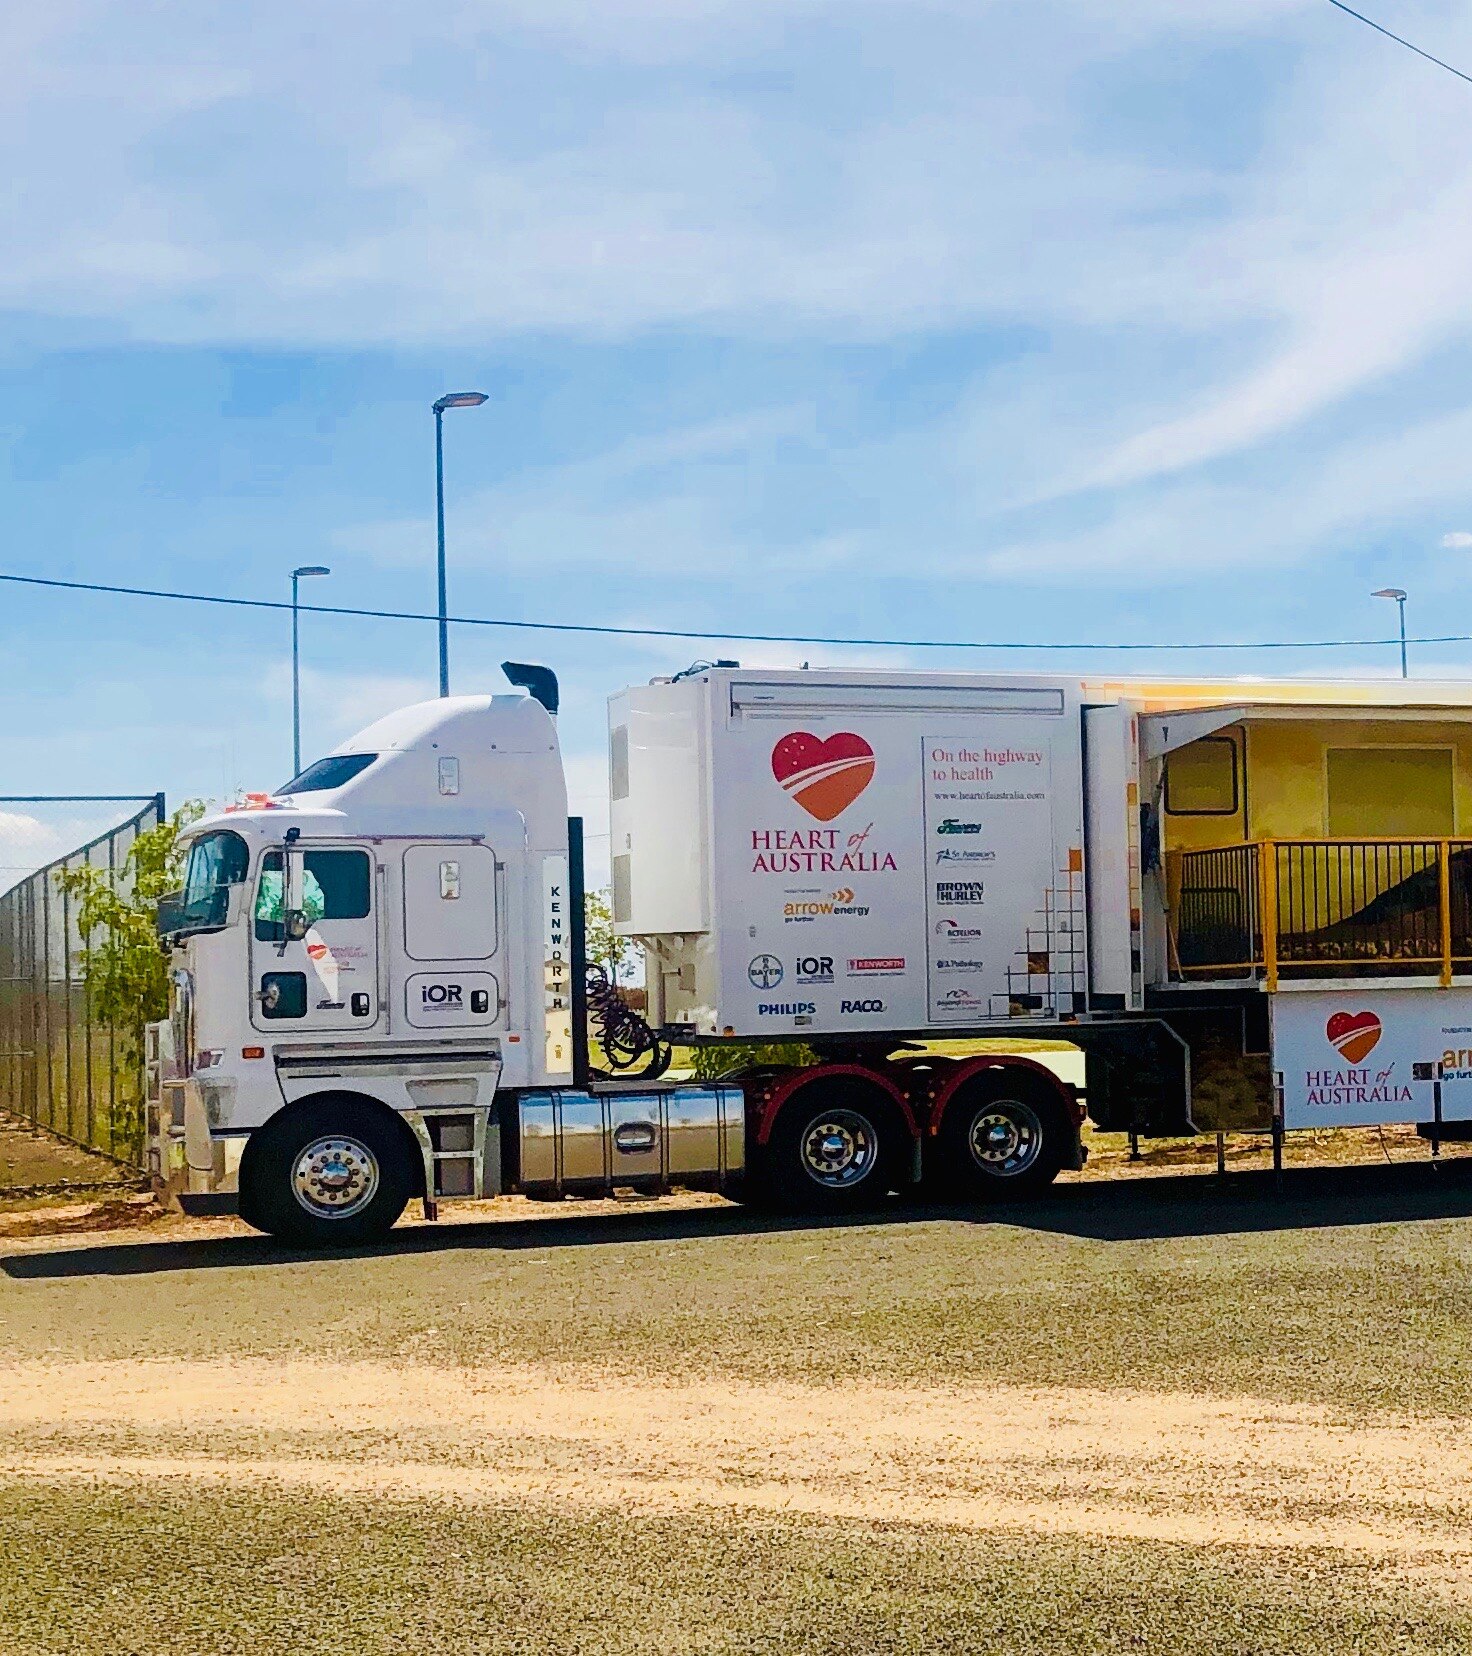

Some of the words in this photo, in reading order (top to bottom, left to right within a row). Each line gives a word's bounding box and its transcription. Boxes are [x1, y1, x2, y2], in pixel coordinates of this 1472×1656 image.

[932, 749, 953, 762] On
[959, 749, 979, 762] the
[984, 749, 1043, 766] highway
[933, 769, 947, 780] to
[951, 767, 994, 780] health
[751, 829, 841, 850] HEART
[847, 822, 874, 859] of
[751, 852, 898, 873] AUSTRALIA
[937, 882, 984, 891] BROWN
[940, 891, 984, 901] HURLEY
[783, 902, 834, 916] arrow
[833, 906, 870, 917] energy
[550, 886, 563, 1010] KENWORTH
[422, 984, 463, 1002] iOR
[758, 1002, 816, 1015] PHILIPS
[840, 999, 884, 1014] RACQ
[1306, 1068, 1371, 1087] HEART
[1375, 1061, 1396, 1091] of
[1307, 1085, 1414, 1106] AUSTRALIA
